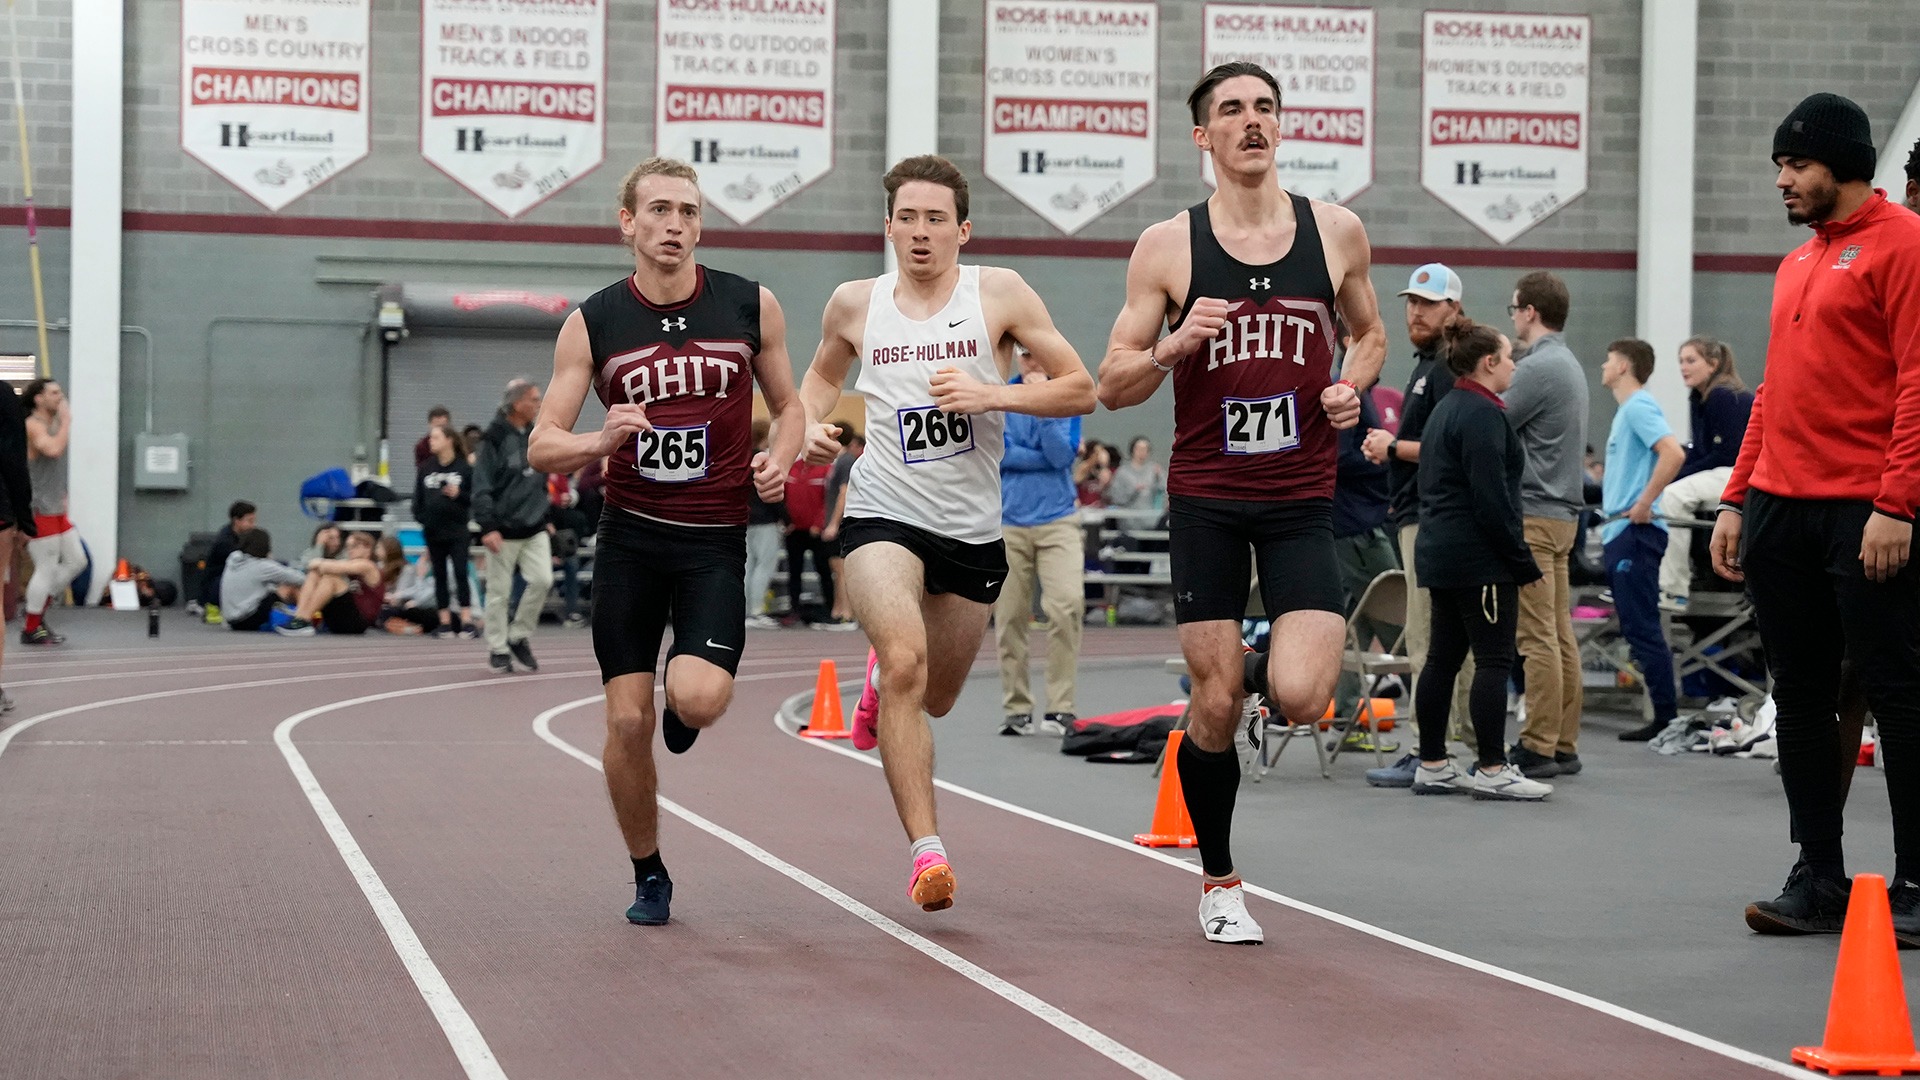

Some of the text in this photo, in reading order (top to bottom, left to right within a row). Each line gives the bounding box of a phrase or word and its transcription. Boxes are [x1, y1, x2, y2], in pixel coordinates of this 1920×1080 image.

[245, 15, 308, 34] MEN'S
[995, 7, 1149, 27] ROSE-HULMAN
[1214, 14, 1367, 34] ROSE-HULMAN
[439, 23, 590, 46] MEN'S INDOOR
[1433, 21, 1582, 41] ROSE-HULMAN
[187, 36, 364, 60] CROSS COUNTRY
[664, 32, 829, 55] MEN'S OUTDOOR
[1026, 46, 1117, 64] WOMEN'S
[439, 45, 590, 70] TRACK & FIELD
[672, 55, 820, 78] TRACK & FIELD
[1300, 54, 1369, 71] INDOOR
[1426, 58, 1587, 77] WOMEN'S OUTDOOR
[193, 73, 359, 106] CHAMPIONS
[987, 67, 1153, 89] CROSS COUNTRY
[1288, 75, 1356, 93] & FIELD
[1446, 79, 1567, 98] TRACK & FIELD
[433, 81, 595, 116] CHAMPIONS
[667, 91, 824, 123] CHAMPIONS
[995, 103, 1147, 133] CHAMPIONS
[1280, 111, 1364, 140] PIONS
[1432, 115, 1579, 144] CHAMPIONS
[219, 121, 334, 148] Heartland
[456, 128, 566, 152] Heartland
[692, 139, 799, 163] Heartland
[1018, 150, 1124, 174] Heartland
[1456, 162, 1556, 185] Heartland
[872, 339, 977, 366] ROSE-HULMAN
[1207, 313, 1315, 372] RHIT
[621, 355, 739, 405] RHIT
[903, 409, 969, 451] 266
[1228, 397, 1292, 442] 271
[639, 429, 705, 470] 265
